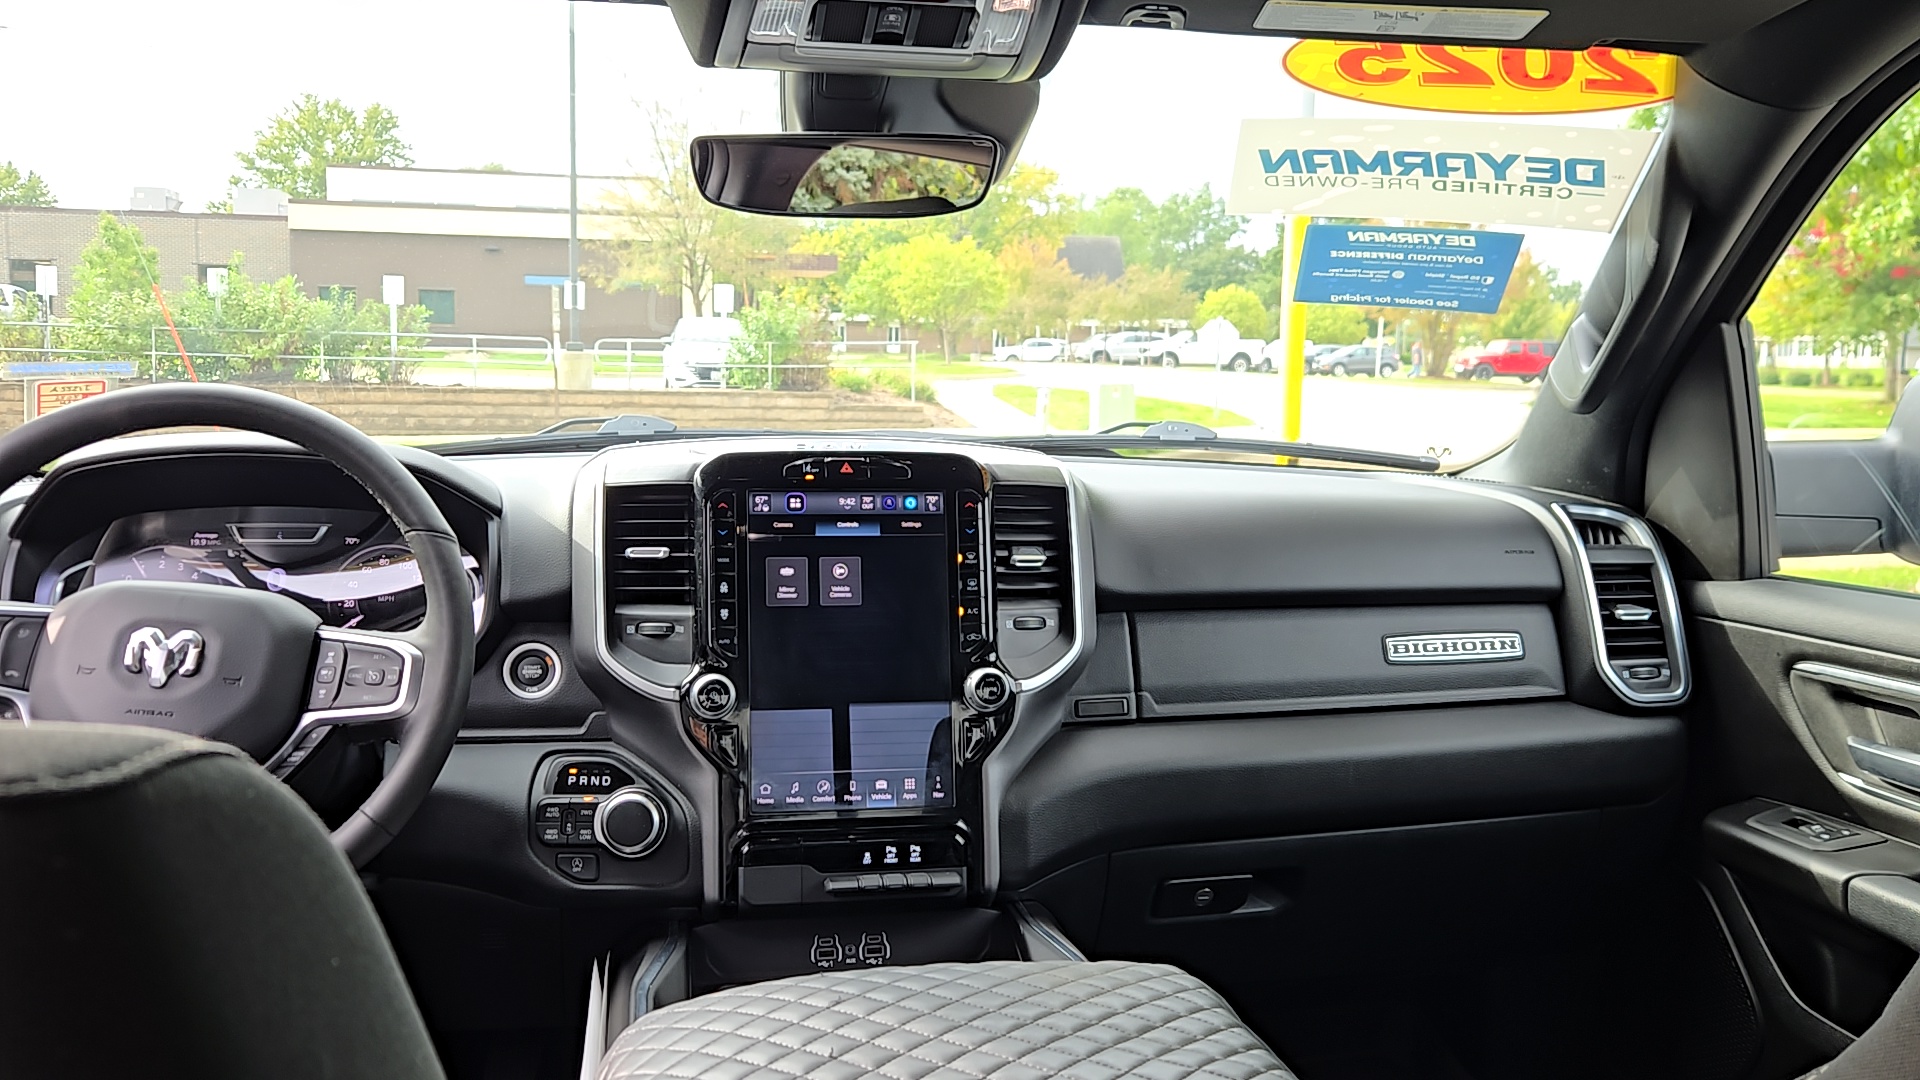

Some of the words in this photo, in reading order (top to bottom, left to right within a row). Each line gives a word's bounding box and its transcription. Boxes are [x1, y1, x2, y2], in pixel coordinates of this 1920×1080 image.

[838, 498, 856, 506] 9:42
[190, 538, 206, 546] 19.9
[191, 572, 198, 580] 4
[1391, 639, 1519, 655] BIGHORN
[786, 796, 804, 804] Media
[844, 794, 862, 802] Phone
[902, 792, 918, 800] Apps
